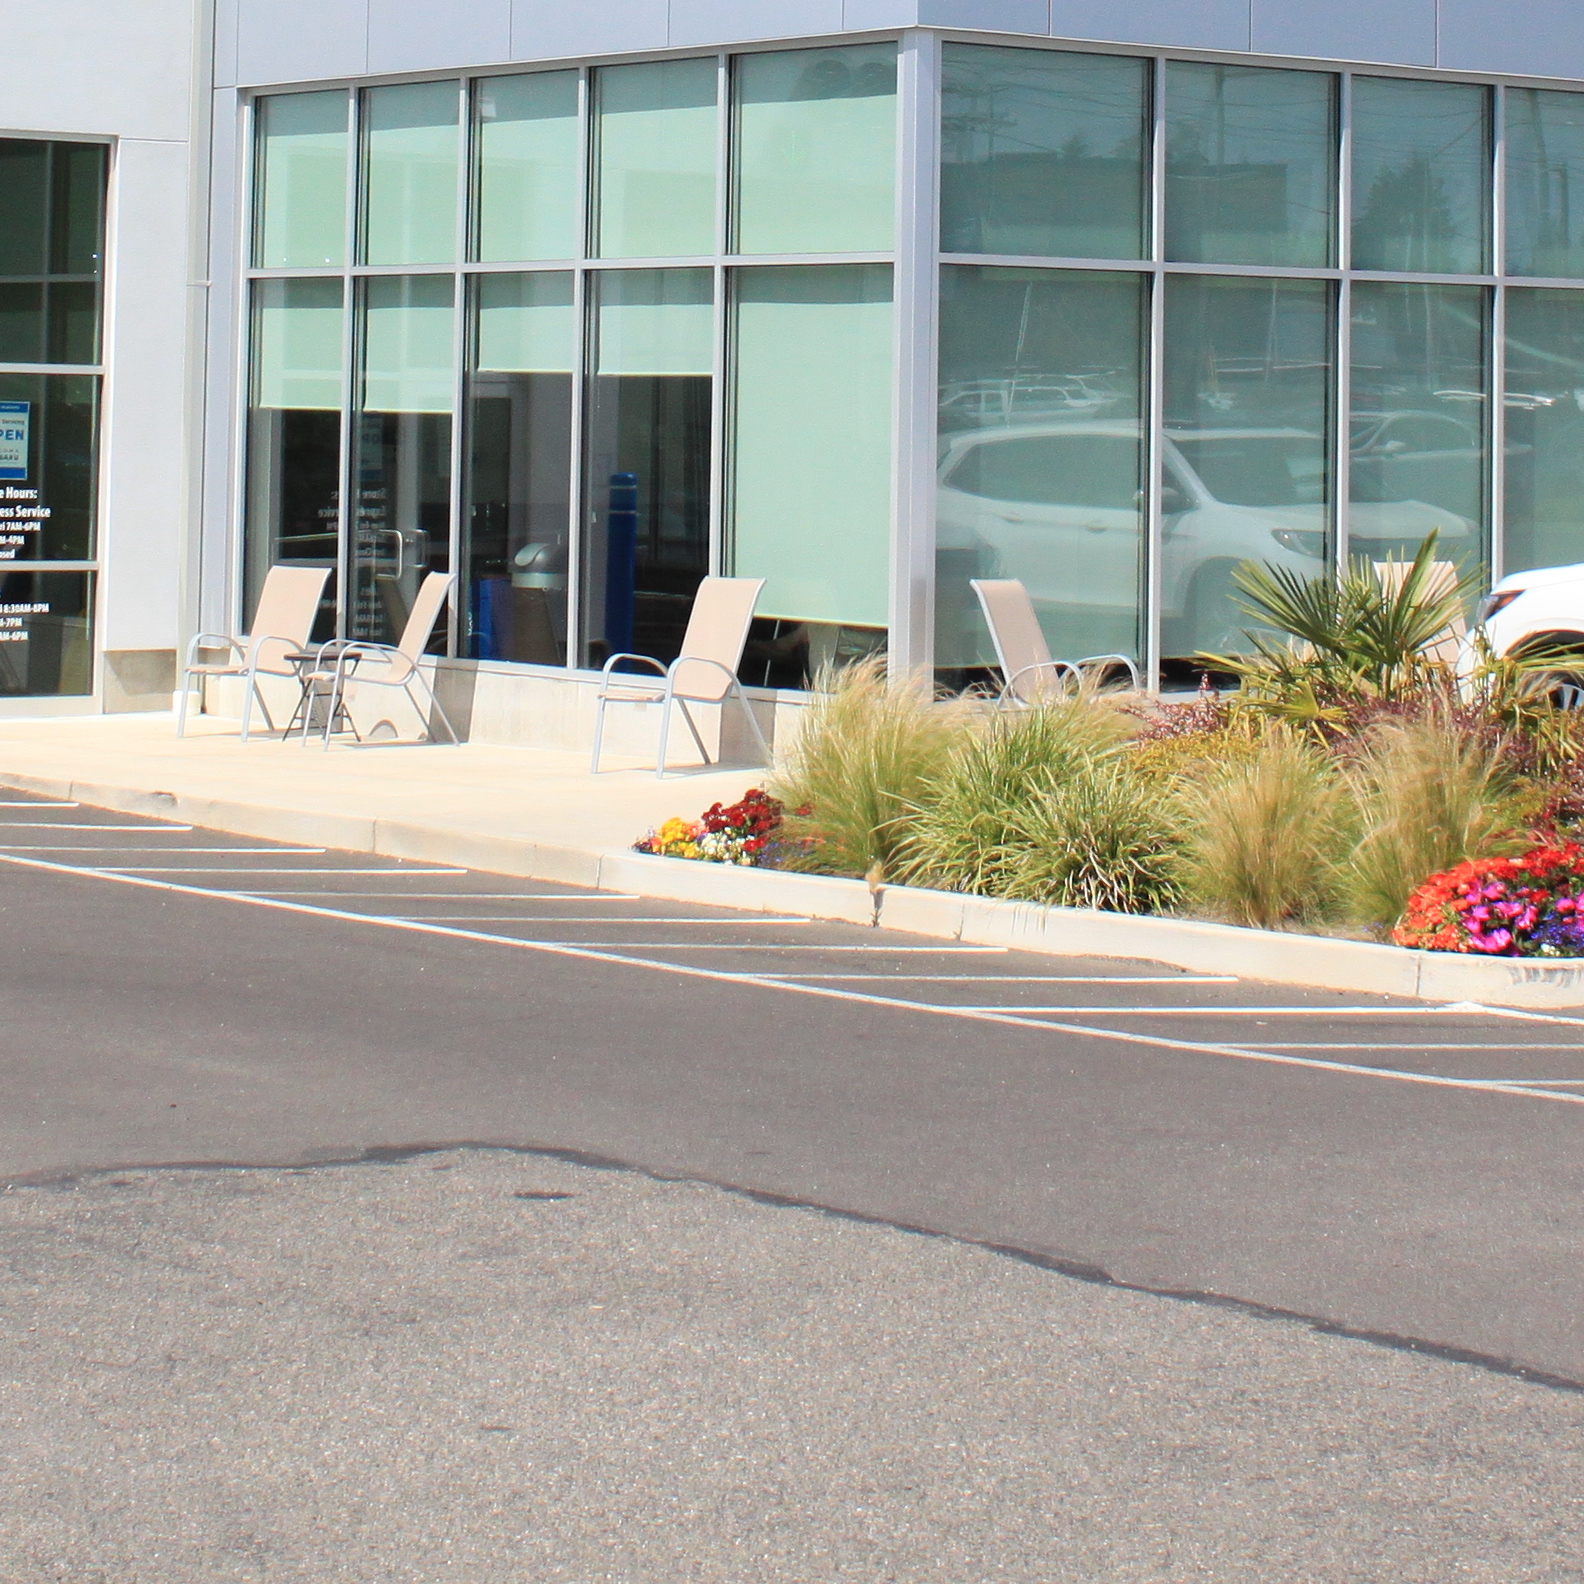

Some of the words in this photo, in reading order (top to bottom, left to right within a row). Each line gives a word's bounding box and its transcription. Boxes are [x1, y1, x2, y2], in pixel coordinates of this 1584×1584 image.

[6, 486, 38, 499] Hours:
[16, 504, 51, 518] Service
[6, 521, 41, 531] 7AM-6PM
